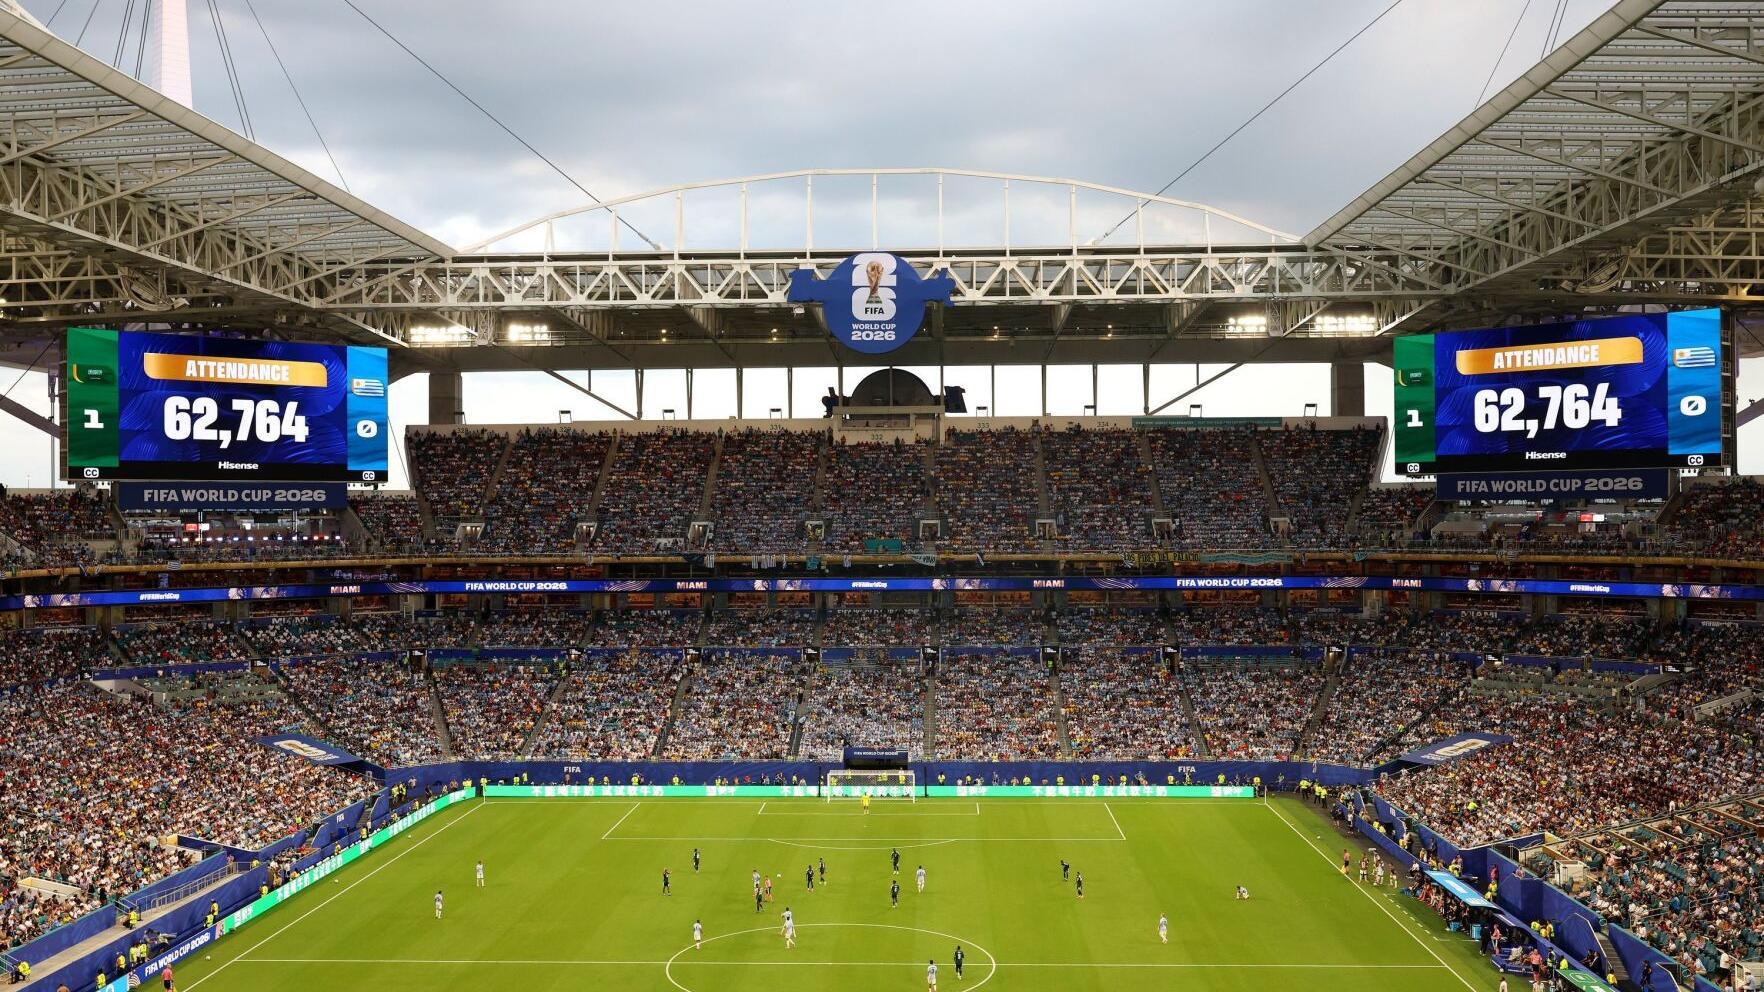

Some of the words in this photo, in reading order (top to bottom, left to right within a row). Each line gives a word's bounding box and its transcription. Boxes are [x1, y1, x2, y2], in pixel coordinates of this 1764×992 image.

[864, 307, 884, 315] FIFA
[851, 331, 896, 341] 2026
[1493, 345, 1600, 369] ATTENDANCE
[185, 359, 289, 381] ATTENDANCE
[1474, 382, 1621, 439] 62,764
[1680, 395, 1707, 416] 0
[84, 409, 104, 429] 1
[163, 396, 309, 448] 62,764
[1407, 409, 1423, 428] 1
[356, 419, 378, 437] 0
[1525, 450, 1567, 460] Hisense
[1688, 455, 1703, 465] CC
[218, 460, 259, 470] Hisense
[1408, 464, 1420, 472] CC
[85, 468, 98, 477] CC
[363, 471, 375, 480] CC
[1457, 480, 1490, 493] FIFA
[1492, 479, 1547, 492] WORLD
[1549, 478, 1582, 491] CUP
[1584, 477, 1643, 490] 2026
[144, 490, 179, 502] FIFA
[180, 490, 239, 502] WORLD
[241, 490, 272, 502] CUP
[274, 490, 327, 502] 2026
[676, 581, 707, 589] MIAMI
[1176, 579, 1196, 587] FIFA
[1197, 579, 1230, 587] WORLD
[1231, 579, 1249, 587] CUP
[1392, 579, 1422, 587] MIAMI
[330, 585, 361, 593] MIAMI
[145, 963, 158, 977] FIFA
[158, 950, 179, 969] WORLD
[179, 943, 191, 956] CUP
[191, 932, 211, 950] 2026
